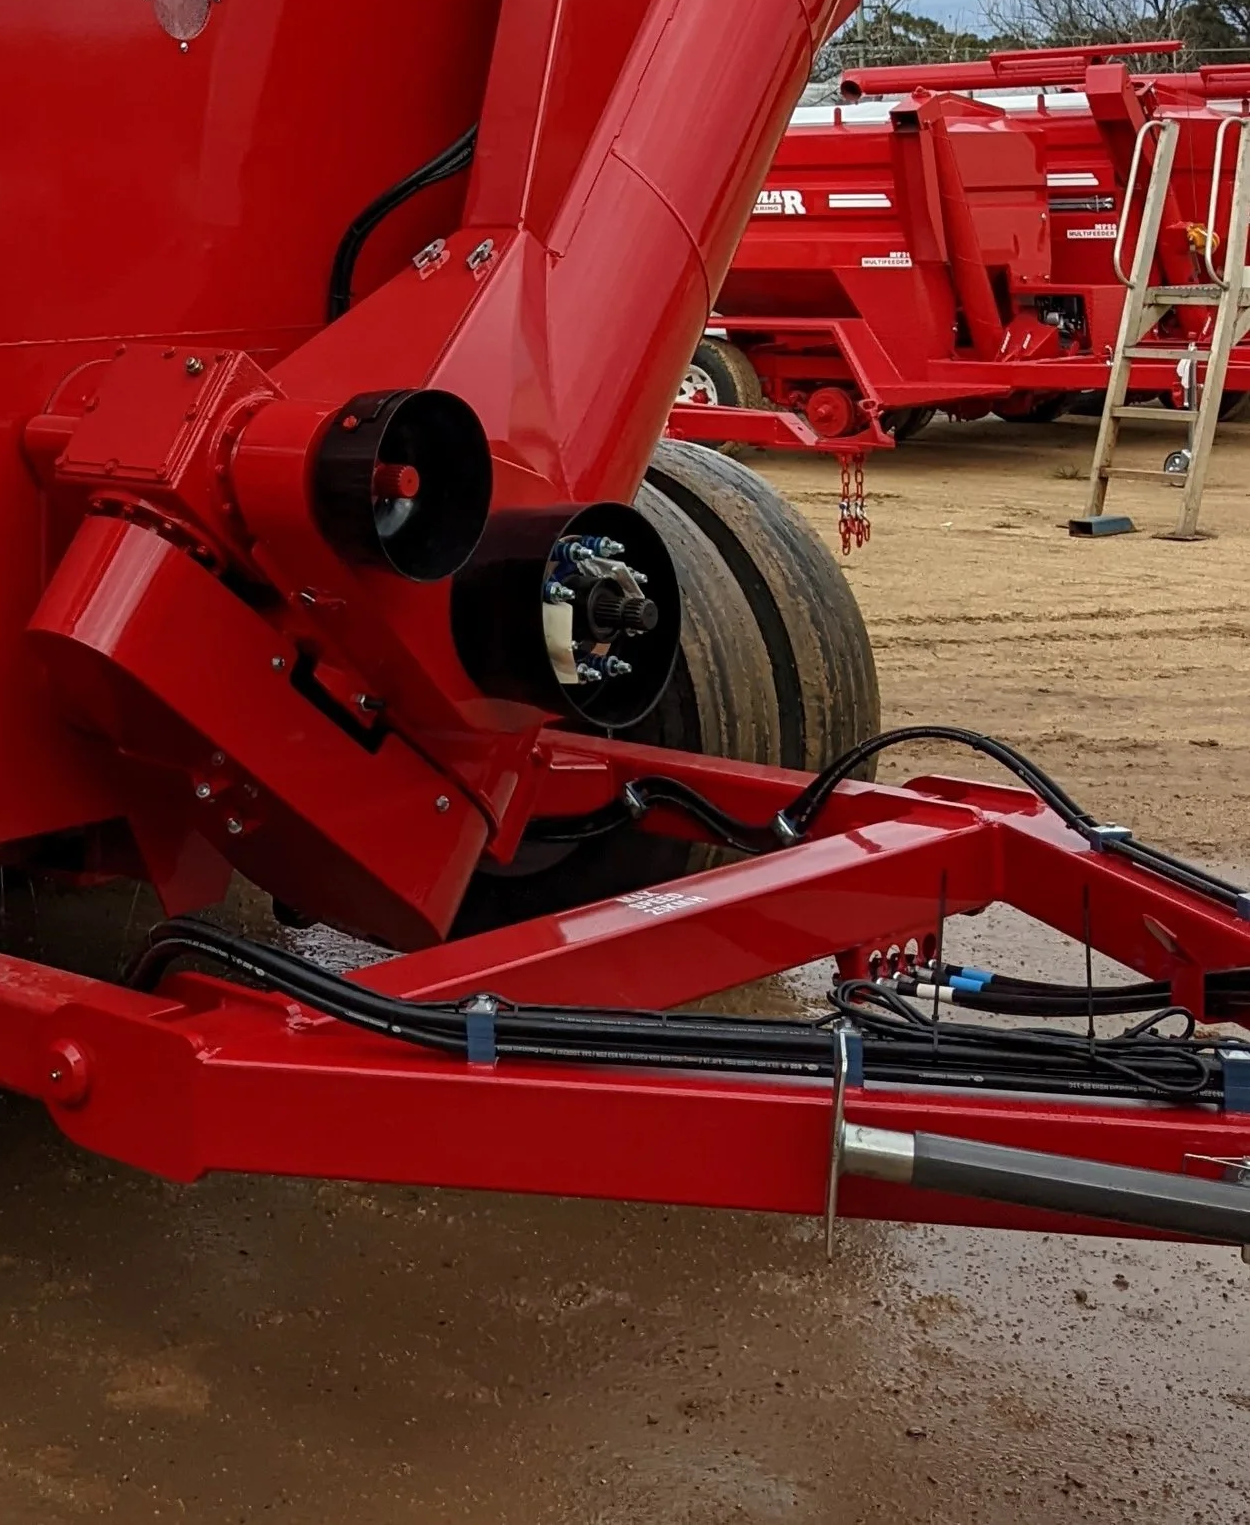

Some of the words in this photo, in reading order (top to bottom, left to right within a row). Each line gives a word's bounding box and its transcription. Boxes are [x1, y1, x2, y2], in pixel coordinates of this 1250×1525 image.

[756, 190, 807, 215] MAR
[615, 890, 660, 904] MAX
[628, 892, 684, 911] SPEED
